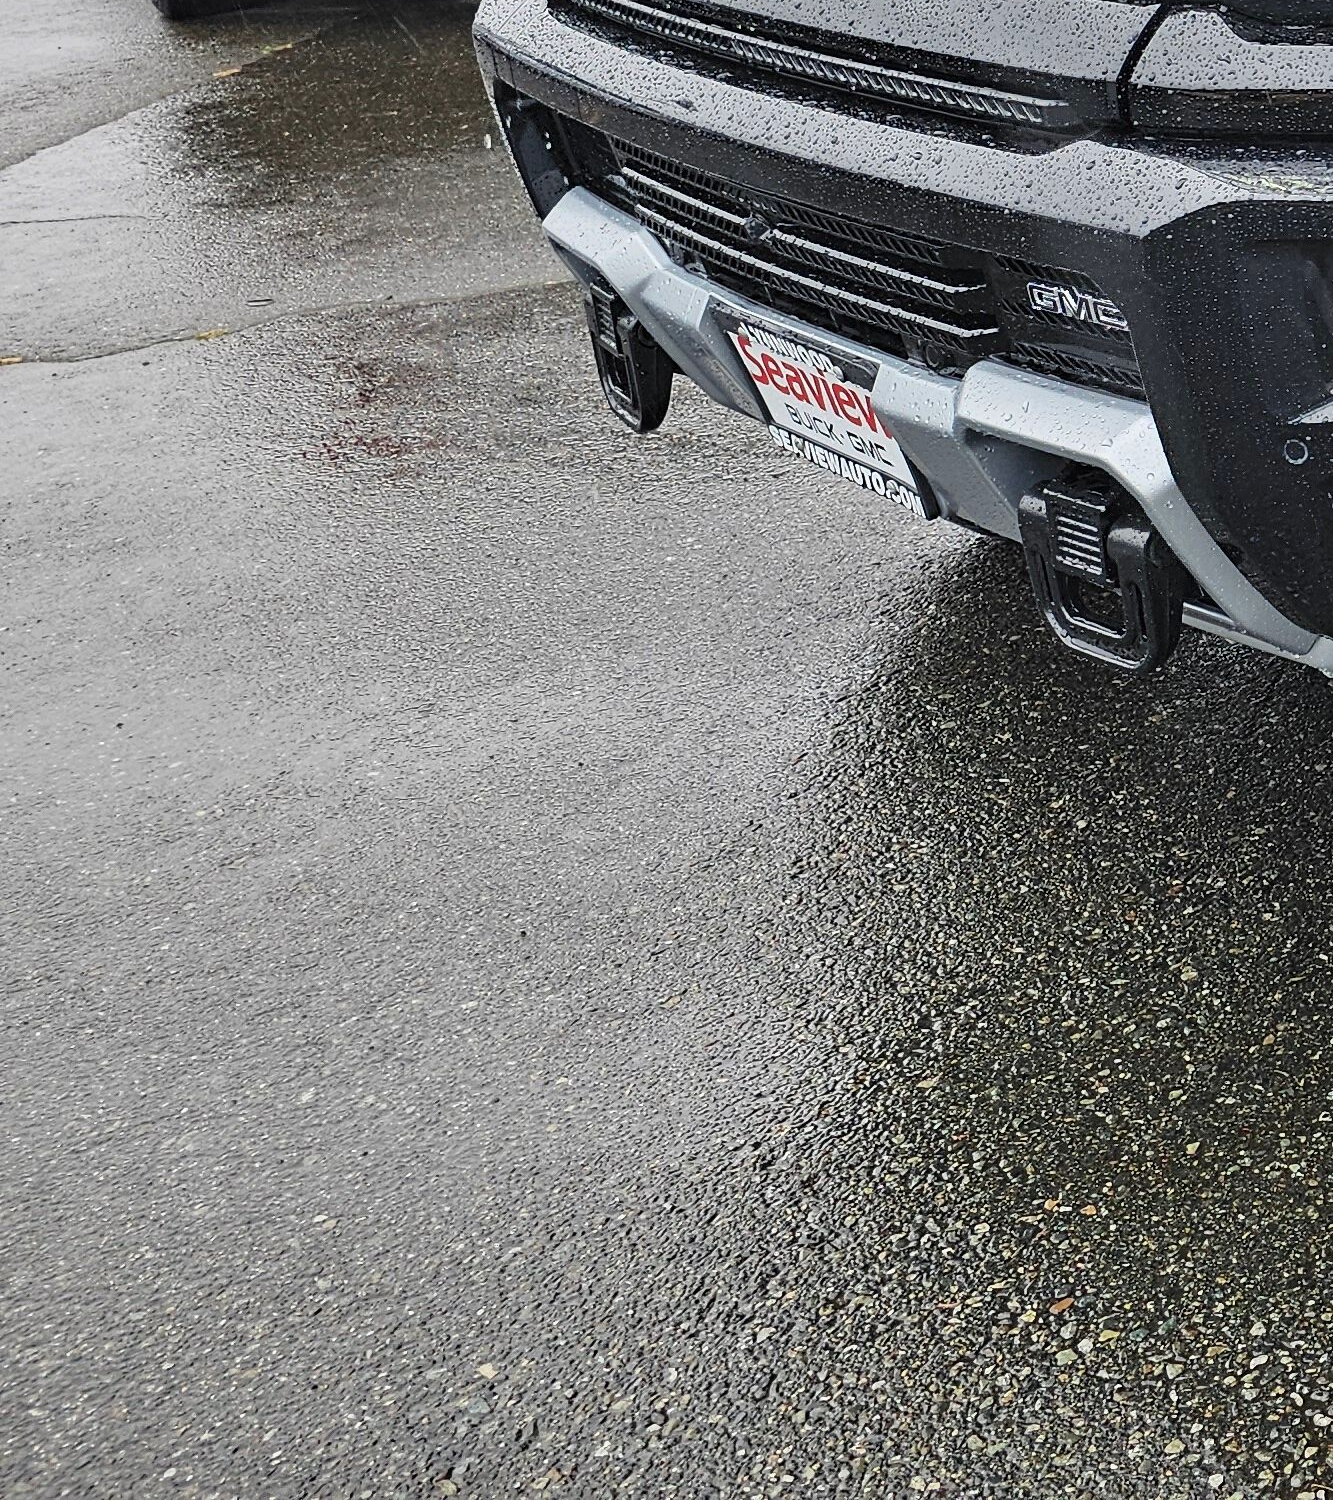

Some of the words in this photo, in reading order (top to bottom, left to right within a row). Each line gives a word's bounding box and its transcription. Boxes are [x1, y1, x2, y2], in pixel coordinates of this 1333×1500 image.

[1026, 281, 1131, 332] GMC
[784, 402, 844, 446] BUICK
[846, 430, 895, 467] GMC
